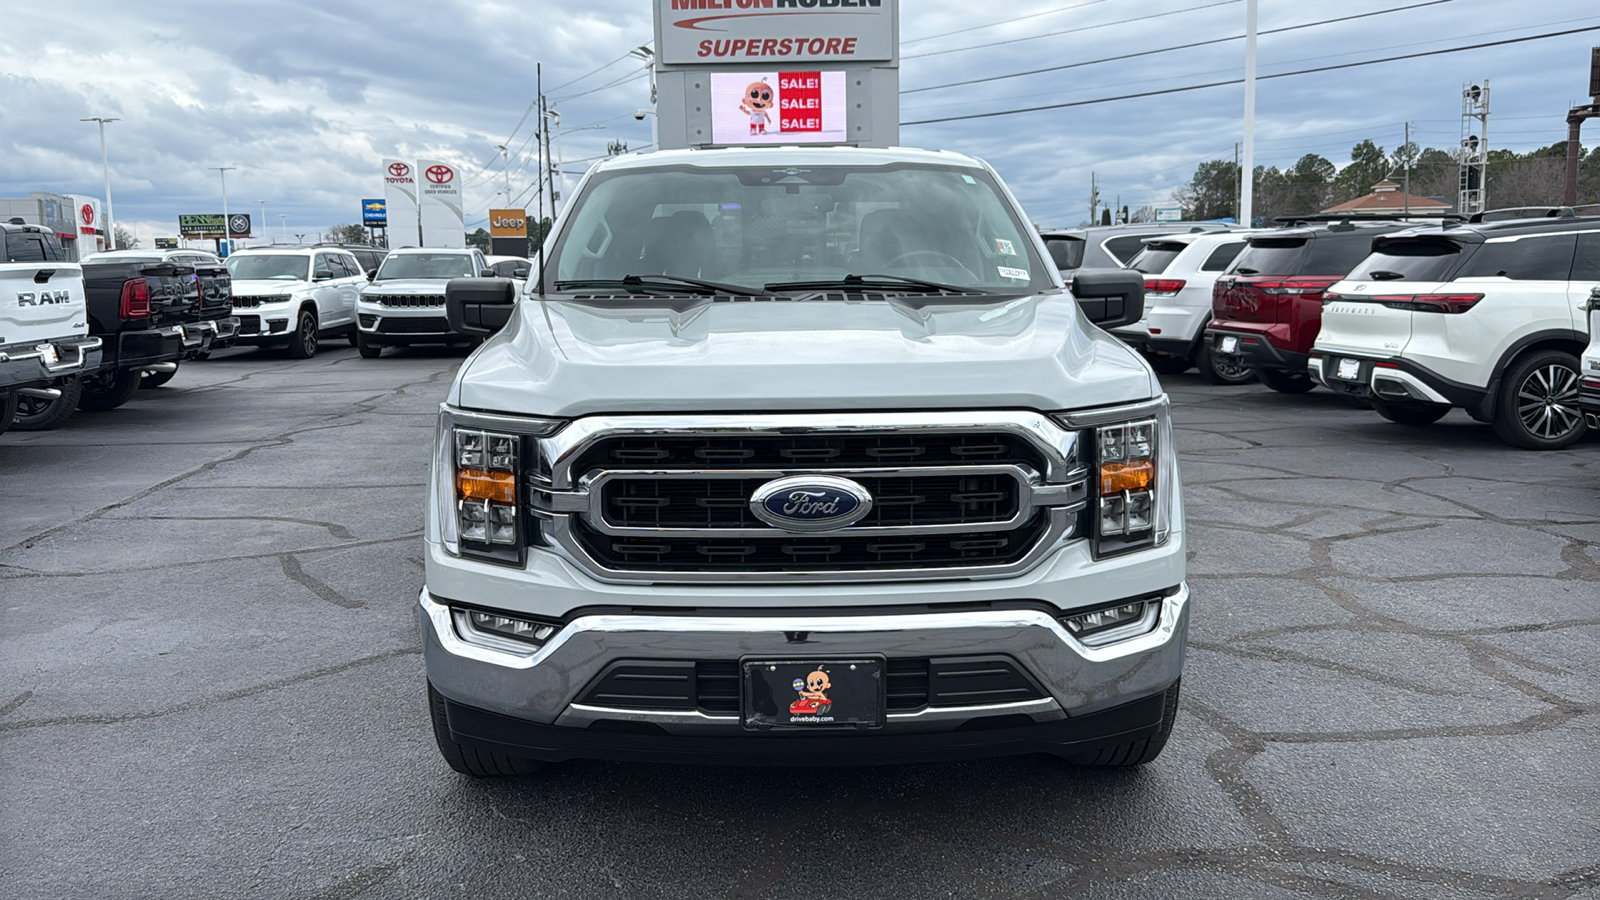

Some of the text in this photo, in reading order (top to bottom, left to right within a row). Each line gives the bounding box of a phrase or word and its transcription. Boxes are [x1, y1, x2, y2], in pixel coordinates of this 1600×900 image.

[697, 37, 858, 57] SUPERSTORE
[780, 78, 819, 89] SALE!
[781, 98, 819, 109] SALE!
[781, 118, 820, 129] SALE!
[493, 216, 524, 230] Jeep
[17, 290, 70, 307] RAM
[783, 490, 840, 515] Ford
